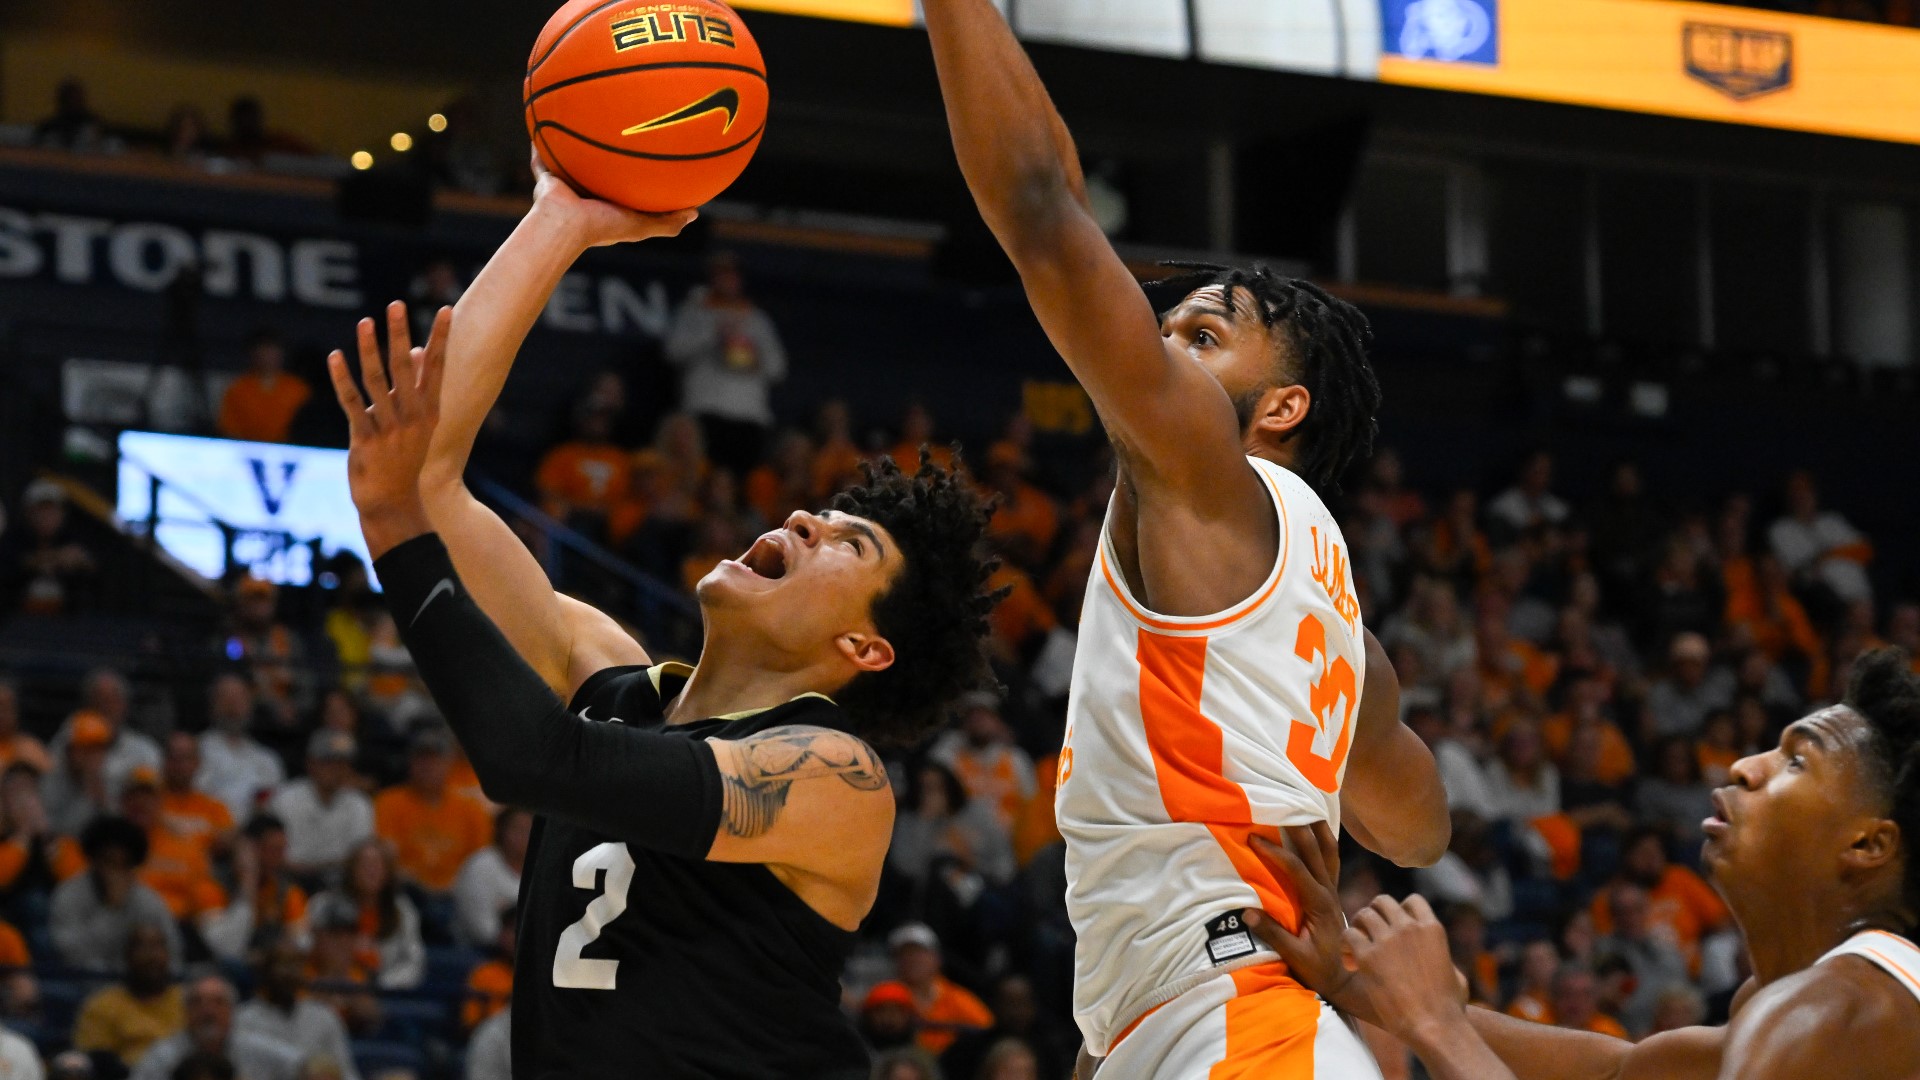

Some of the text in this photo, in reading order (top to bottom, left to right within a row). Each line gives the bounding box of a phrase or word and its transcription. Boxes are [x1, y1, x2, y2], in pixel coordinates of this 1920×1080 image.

[610, 12, 736, 53] ELITE
[1286, 612, 1357, 794] 30
[552, 841, 636, 991] 2
[1216, 915, 1239, 932] 48
